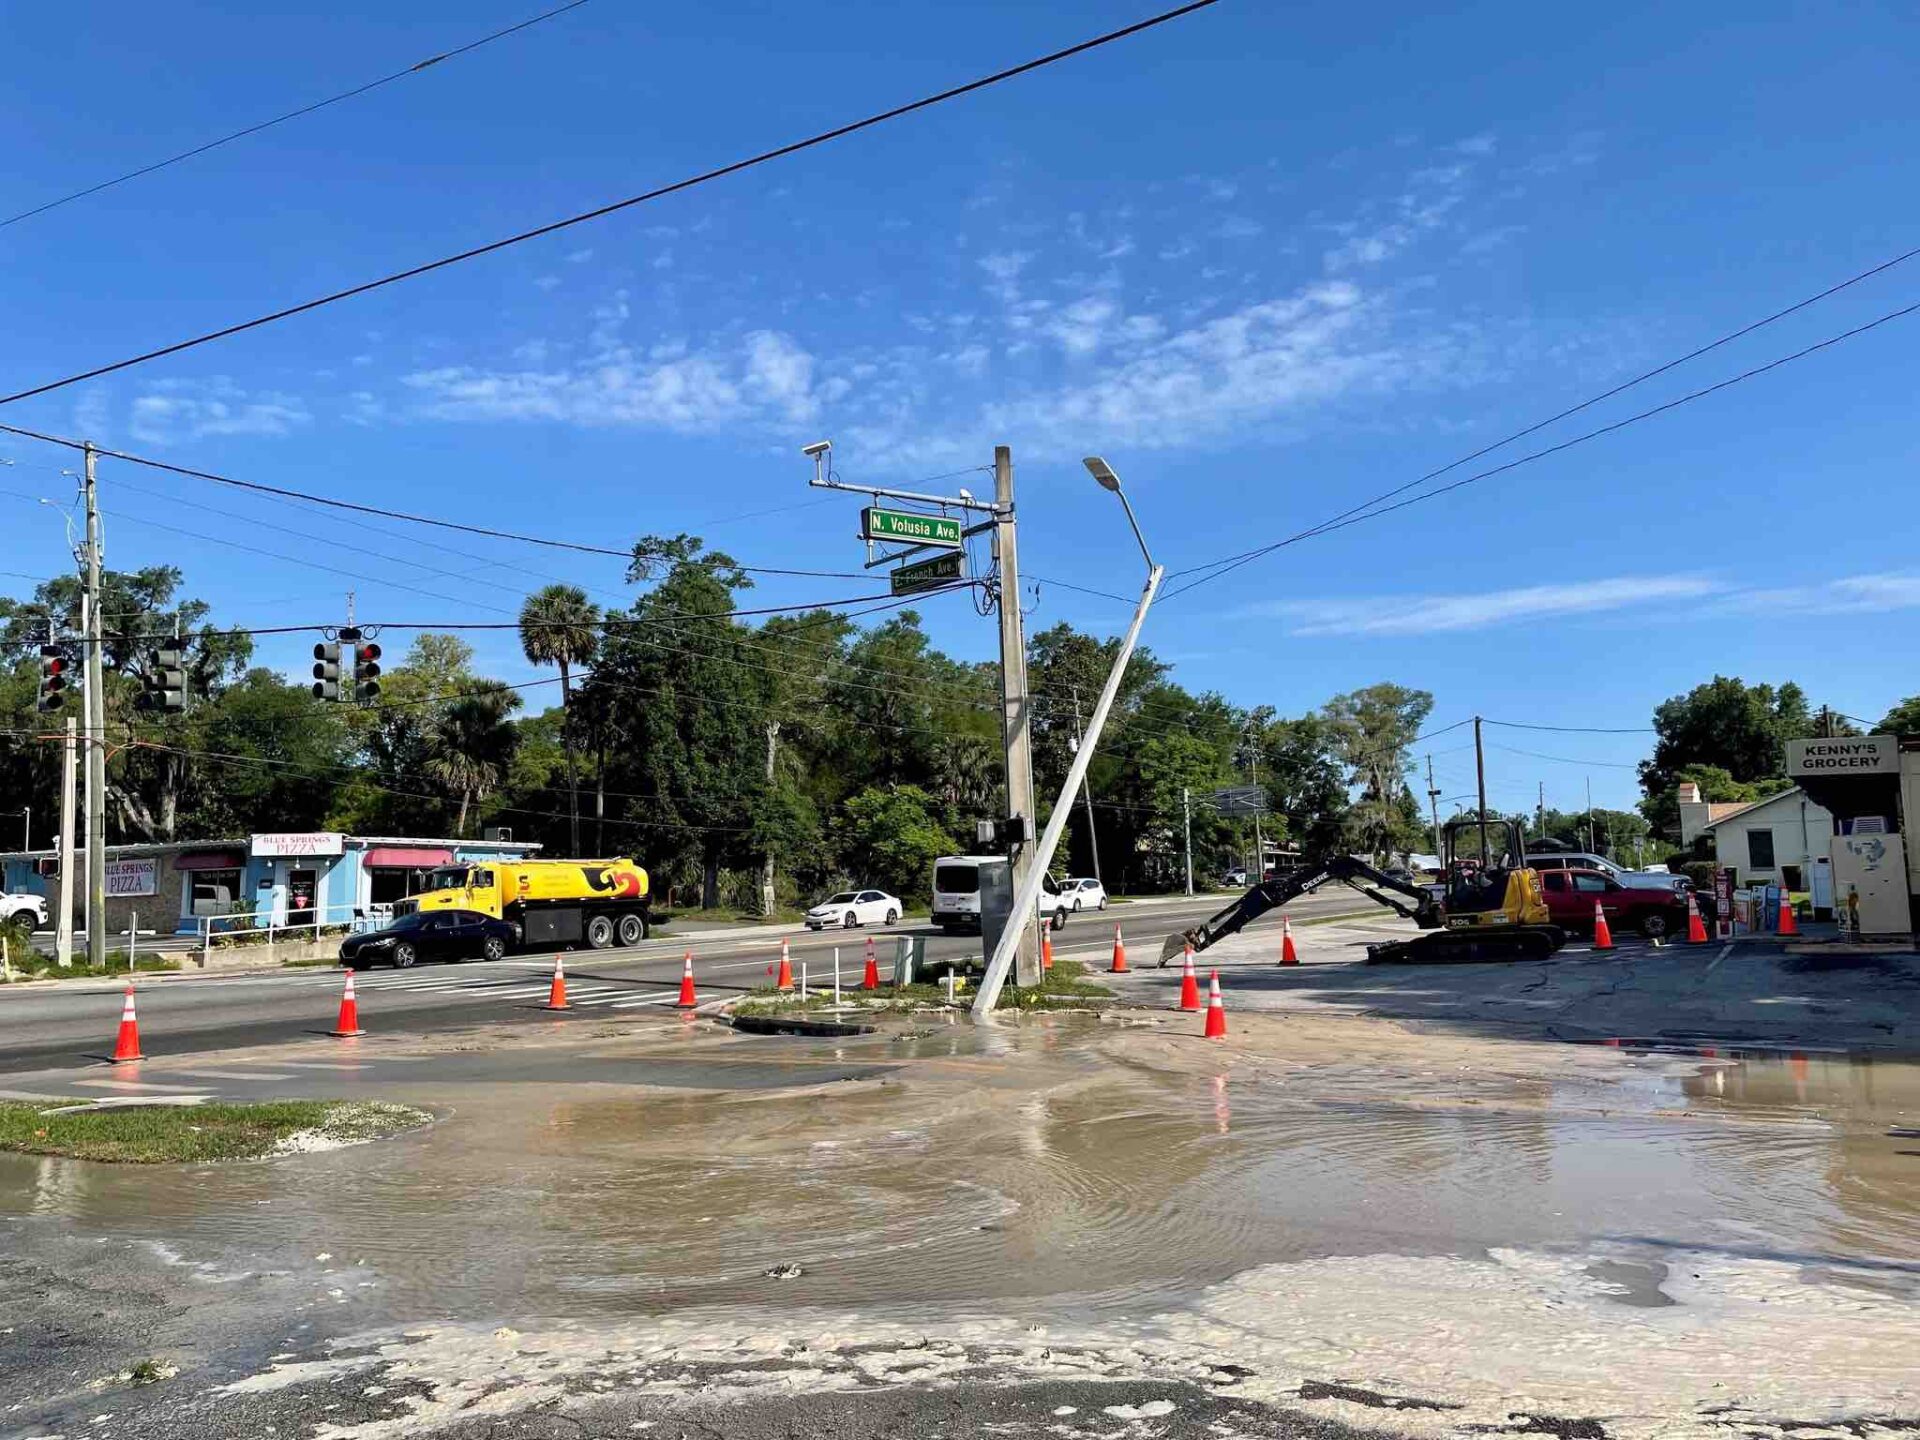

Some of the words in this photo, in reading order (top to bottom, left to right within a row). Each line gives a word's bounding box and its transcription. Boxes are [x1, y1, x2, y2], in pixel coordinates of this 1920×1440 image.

[873, 515, 884, 530] N.
[891, 517, 930, 535] Volusia
[936, 523, 958, 539] Ave.
[937, 562, 955, 574] Ave.
[1805, 744, 1877, 756] KENNY'S
[1802, 756, 1881, 769] GROCERY
[263, 836, 286, 844] BLUE
[290, 835, 331, 844] SPRINGS
[276, 843, 316, 854] PIZZA
[121, 861, 154, 875] SPRINGS
[110, 875, 143, 893] PIZZA
[1301, 871, 1330, 891] DEERE
